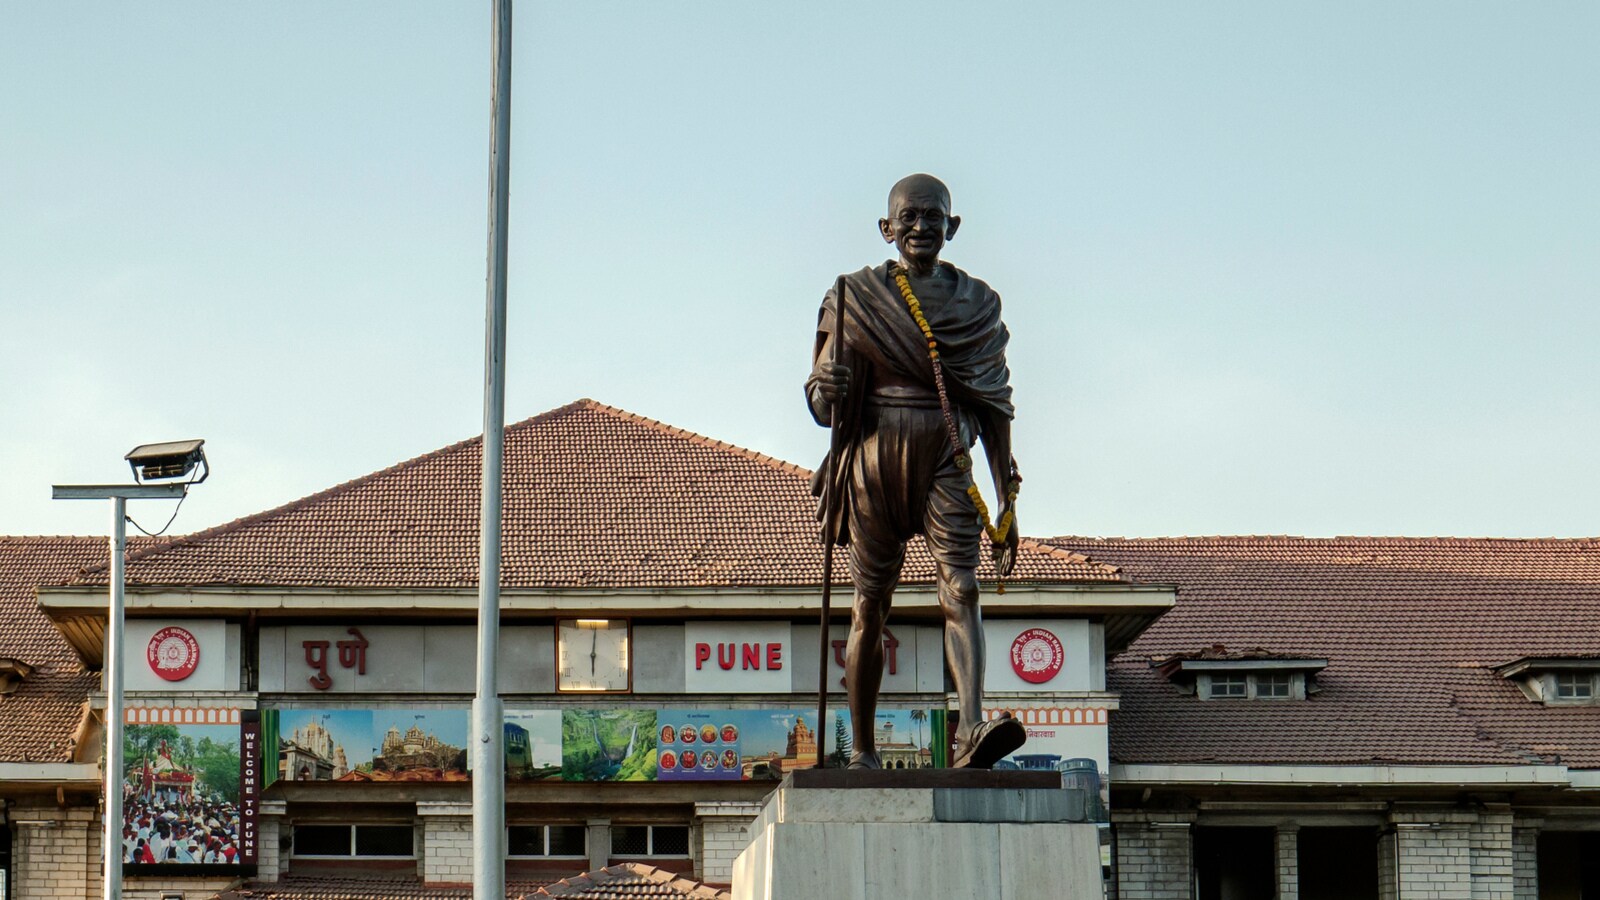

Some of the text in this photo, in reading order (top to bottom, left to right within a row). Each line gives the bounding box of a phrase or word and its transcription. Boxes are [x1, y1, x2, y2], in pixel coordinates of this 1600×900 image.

[170, 628, 197, 669] INDIAN RAILWAYS
[302, 627, 369, 690] पुणे
[695, 642, 783, 671] PUNE
[1032, 629, 1062, 670] INDIAN RAILWAYS
[1026, 728, 1056, 738] निवारवाडा
[245, 733, 255, 856] WELCOME TO PUNE
